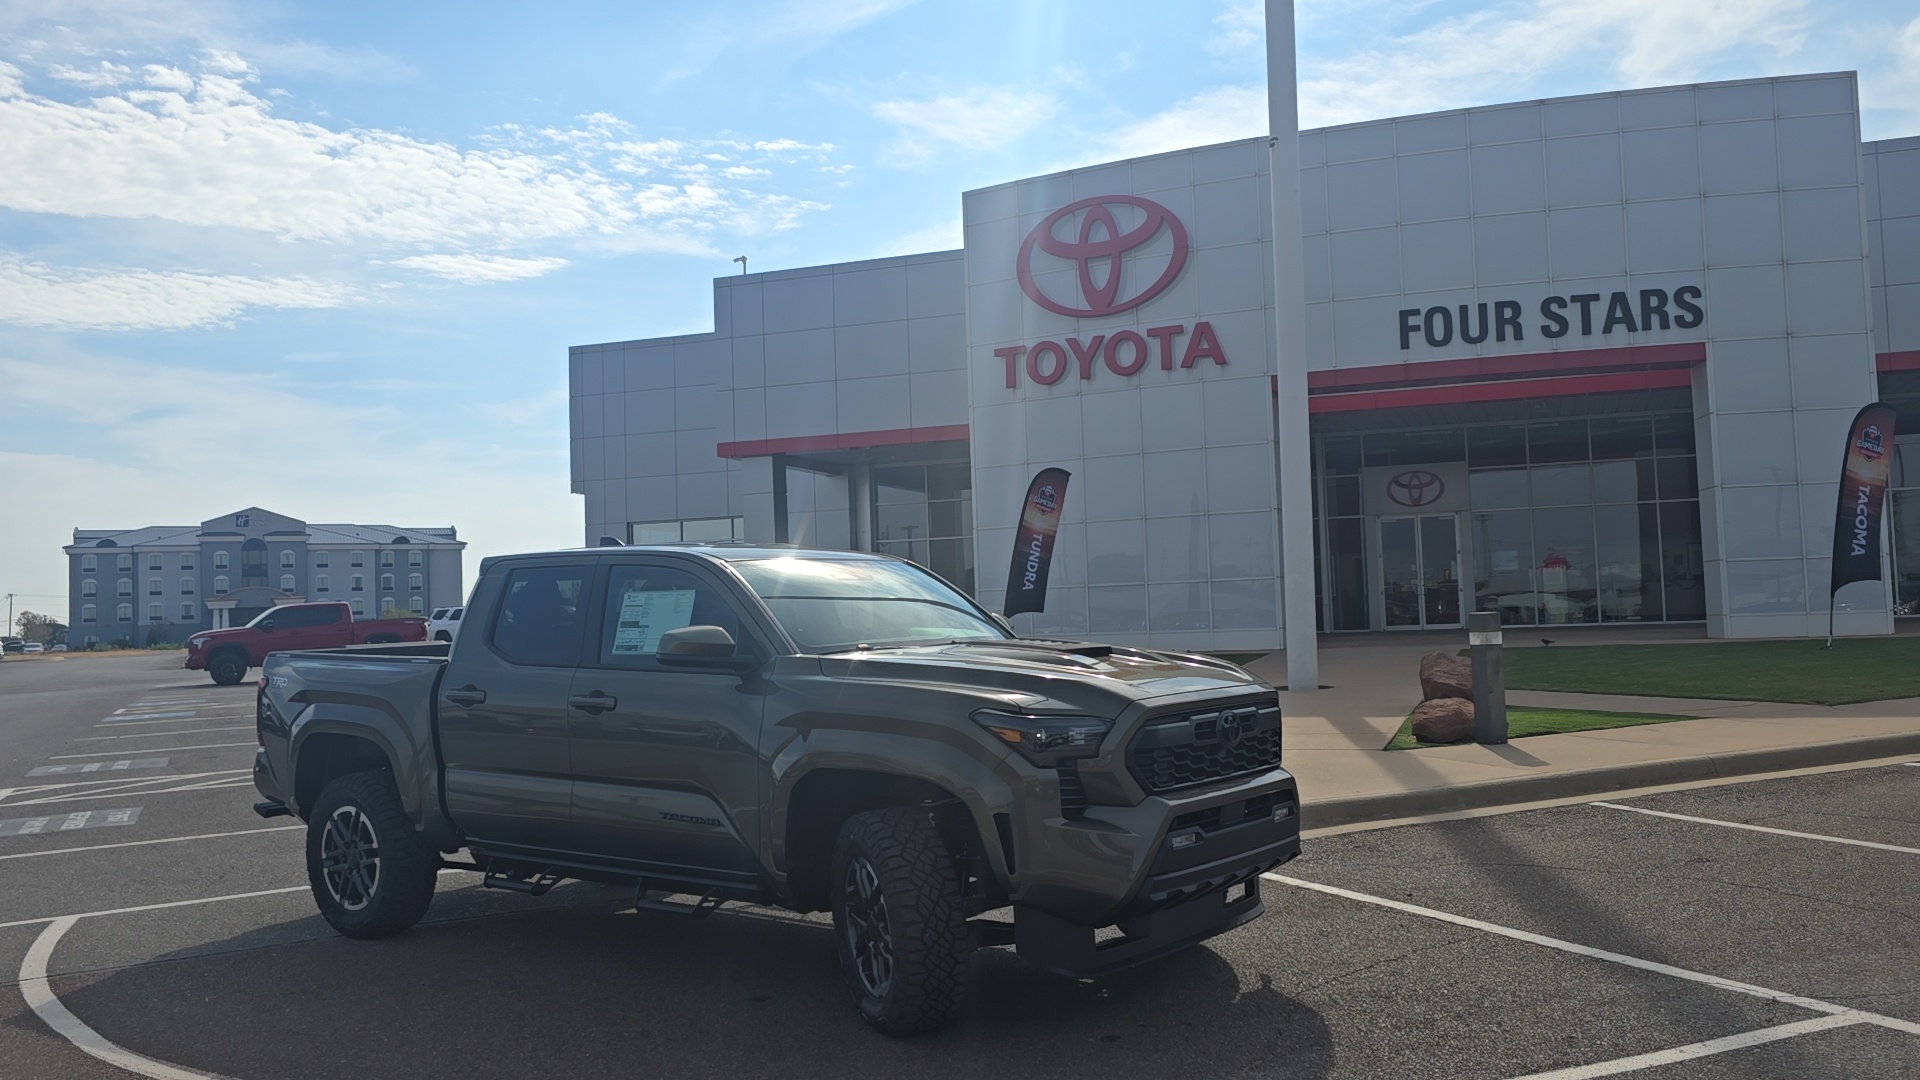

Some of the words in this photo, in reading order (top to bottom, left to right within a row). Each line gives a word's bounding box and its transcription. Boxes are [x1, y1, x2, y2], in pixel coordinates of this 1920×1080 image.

[1399, 300, 1524, 350] FOUR
[1540, 285, 1704, 339] STARS
[993, 321, 1229, 389] TOYOTA
[1851, 485, 1870, 557] TACOMA
[1022, 534, 1043, 591] TUNDRA
[273, 676, 289, 689] TRD
[659, 812, 725, 827] TACOMA
